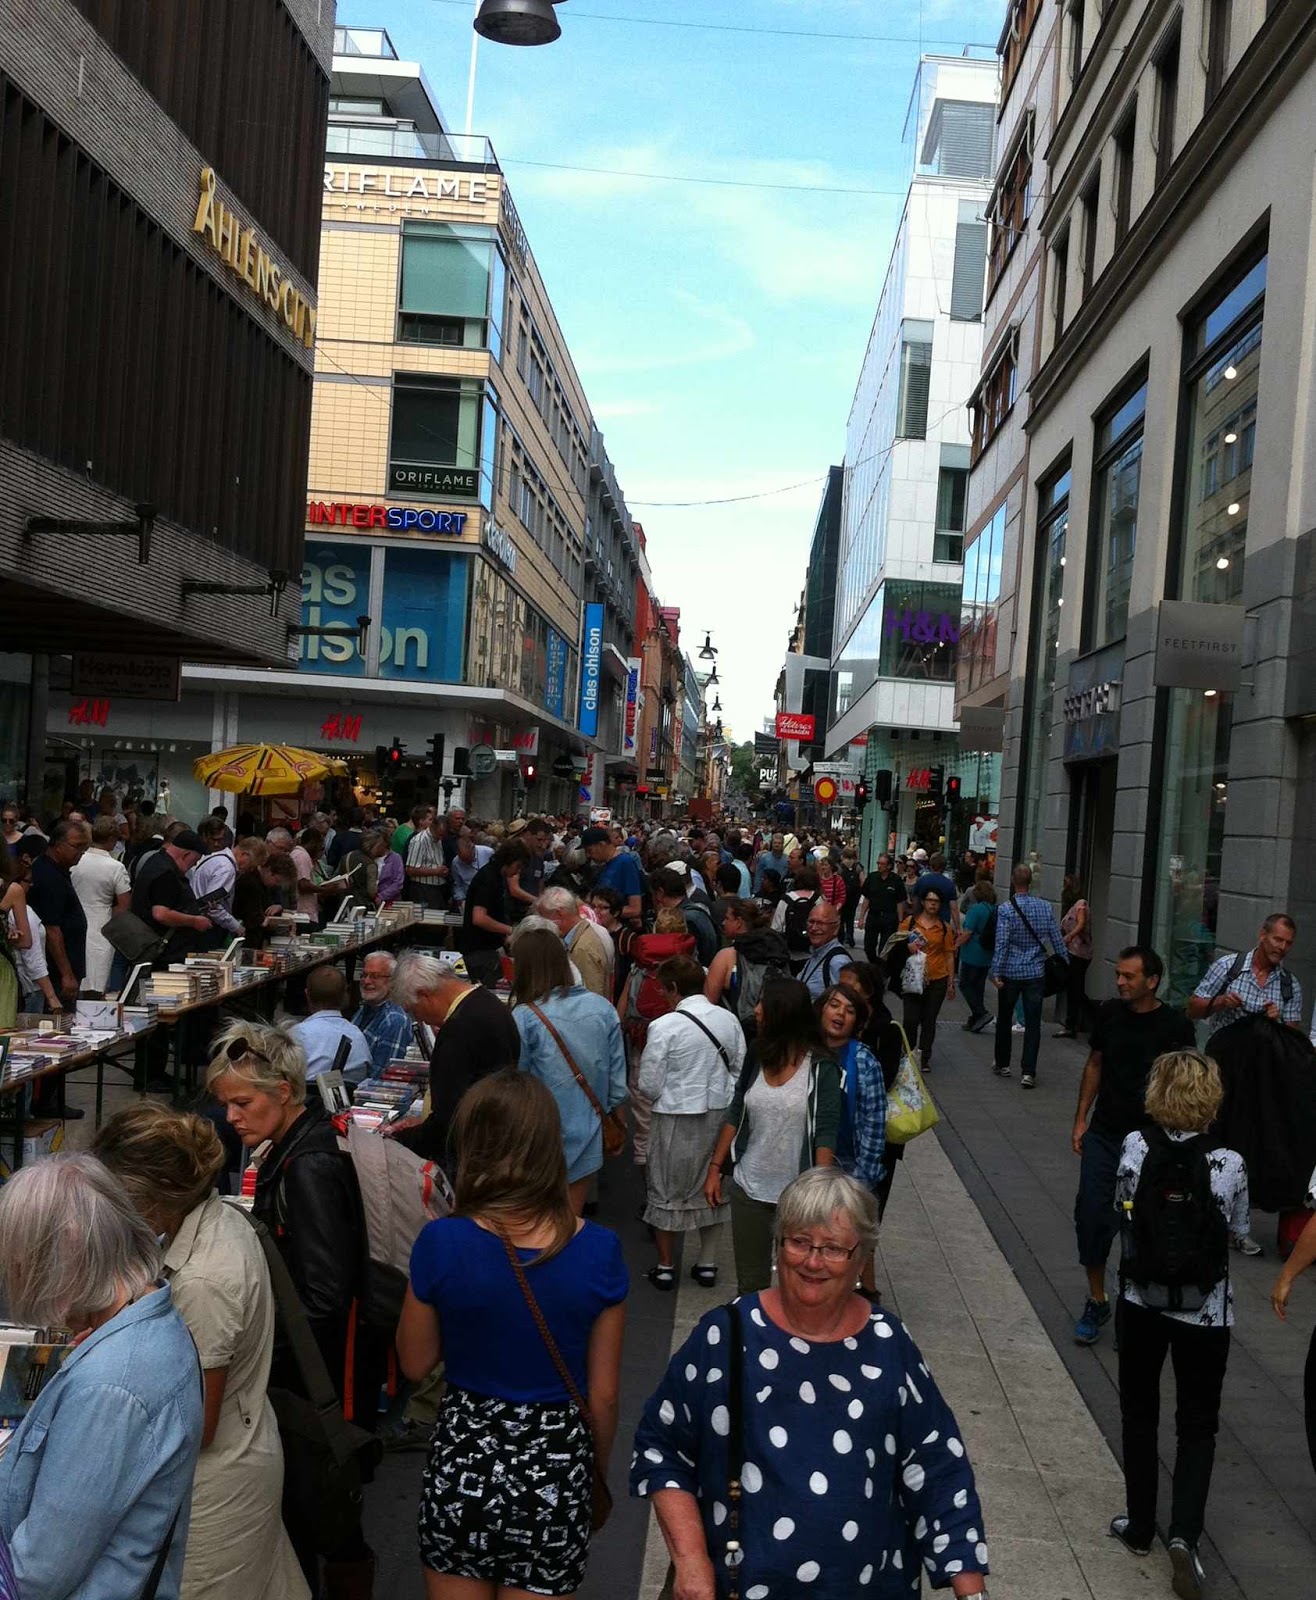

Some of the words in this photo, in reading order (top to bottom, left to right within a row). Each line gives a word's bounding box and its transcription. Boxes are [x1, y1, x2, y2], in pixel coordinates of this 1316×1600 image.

[341, 203, 430, 215] SWEDEN
[395, 470, 475, 487] ORIFLAME
[308, 501, 468, 536] INTERSPORT
[297, 606, 429, 668] lson
[584, 627, 601, 677] ohlson
[1164, 638, 1237, 652] FEETFIRST
[583, 679, 598, 710] clas
[320, 713, 363, 742] H&M
